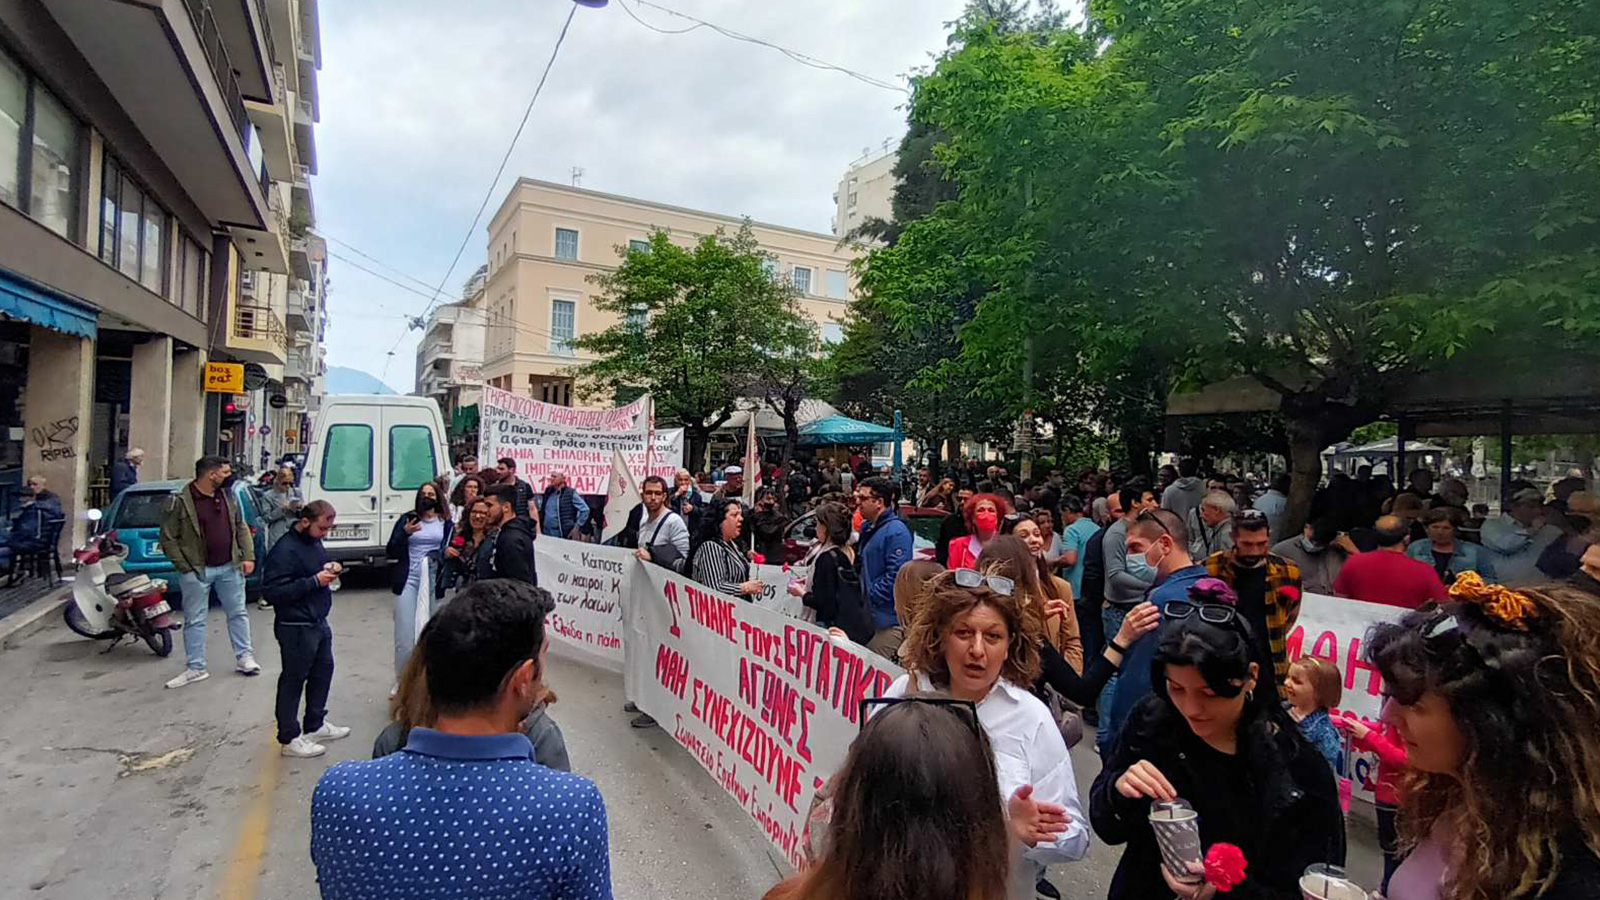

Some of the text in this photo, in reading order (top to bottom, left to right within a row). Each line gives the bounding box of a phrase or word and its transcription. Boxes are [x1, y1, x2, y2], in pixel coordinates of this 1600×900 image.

[209, 365, 231, 373] box
[209, 375, 232, 383] eat
[498, 419, 509, 433] Ο
[511, 422, 561, 437] πόλεμος
[496, 446, 534, 460] ΚΑΜΙΑ
[543, 448, 601, 462] ΕΜΠΛΟΚΗ
[581, 552, 624, 574] Κάποτε
[558, 573, 569, 584] οι
[684, 584, 738, 644] ΤΙΜΑΜΕ
[740, 621, 783, 669] ΤΟΥΣ
[586, 632, 593, 644] η
[739, 657, 815, 764] ΑΓΩΝΕΣ
[655, 643, 807, 815] ΜΑΗ ΣΥΝΕΧΙΖΟΥΜΕ
[674, 713, 714, 771] Σωματείο
